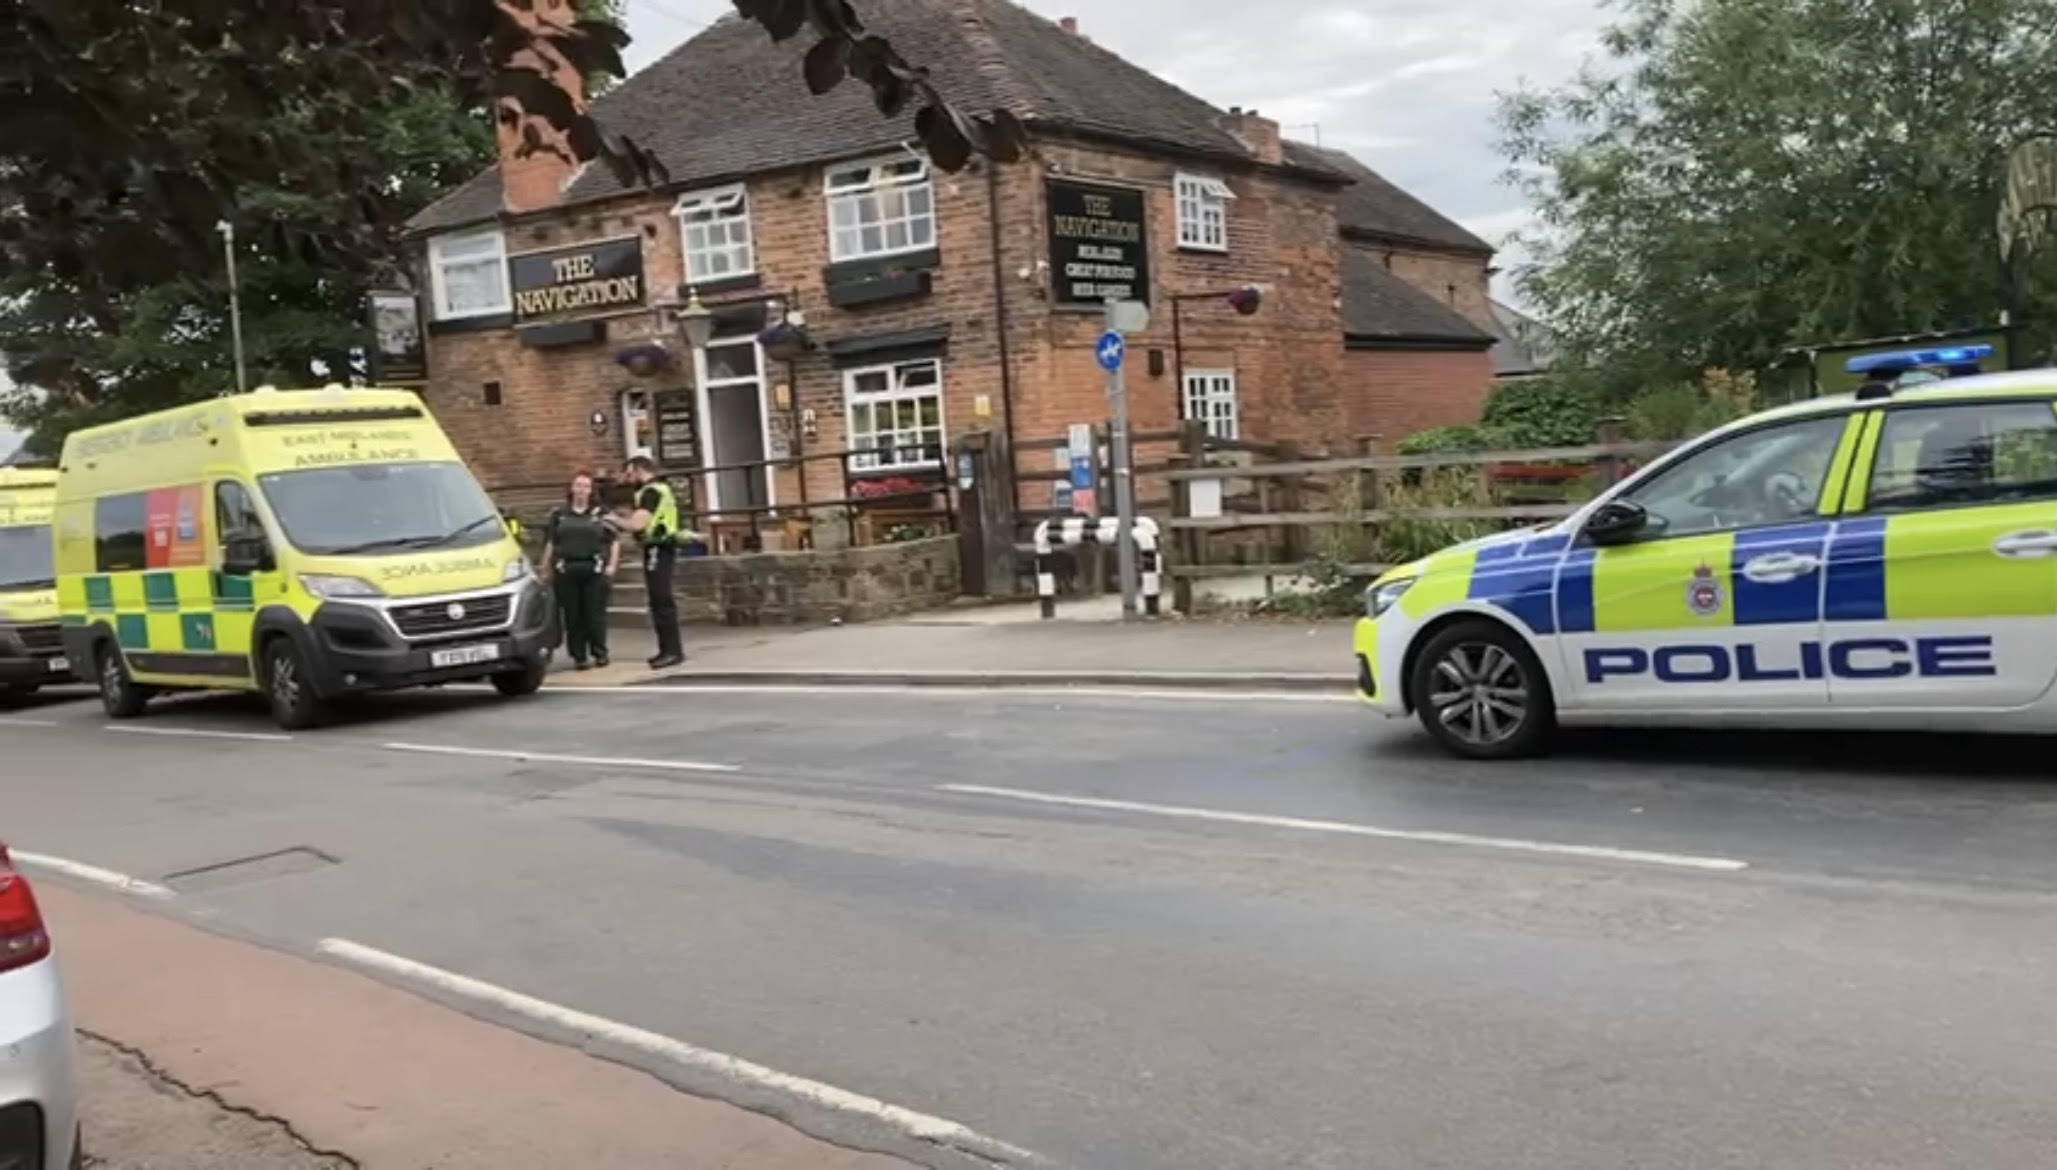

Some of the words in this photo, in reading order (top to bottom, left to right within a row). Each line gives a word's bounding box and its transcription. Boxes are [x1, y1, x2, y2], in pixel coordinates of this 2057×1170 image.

[1083, 194, 1111, 217] THE
[1055, 214, 1139, 242] NAVIGATION
[552, 253, 595, 282] THE
[514, 275, 638, 316] NAVIGATION
[282, 430, 326, 448] EAST
[295, 448, 418, 467] AMBULANCE
[1583, 635, 1997, 684] POLICE
